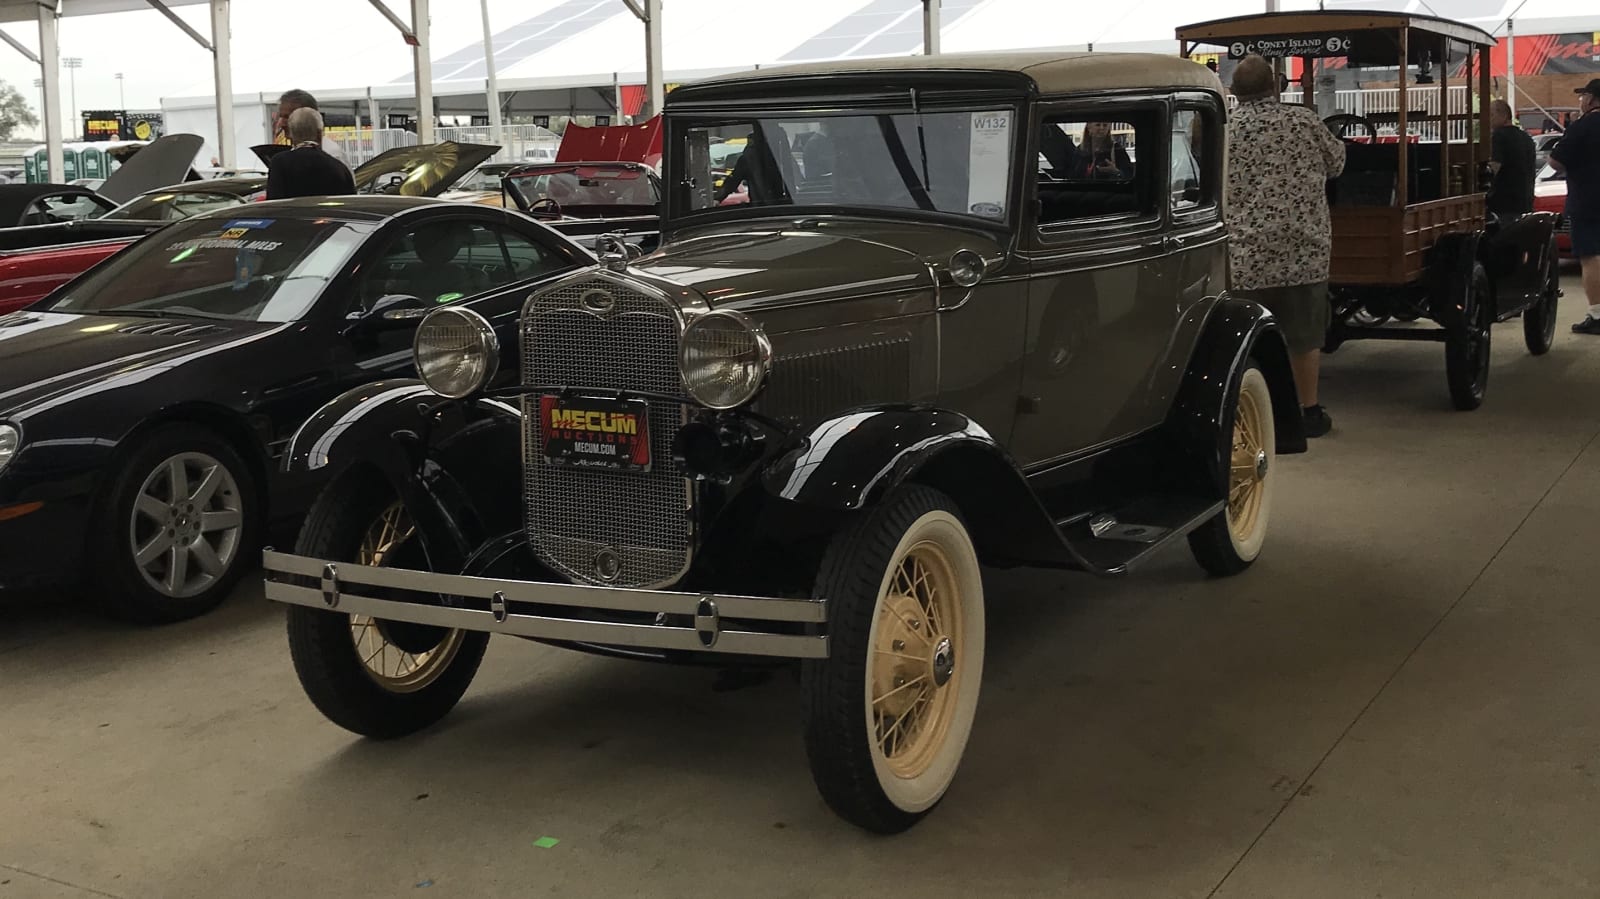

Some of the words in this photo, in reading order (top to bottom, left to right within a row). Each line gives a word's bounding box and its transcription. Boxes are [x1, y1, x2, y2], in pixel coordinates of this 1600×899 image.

[1257, 40, 1288, 50] CONEY
[1289, 38, 1322, 48] ISLAND
[974, 118, 1007, 129] W132
[551, 408, 637, 435] MECUM
[551, 430, 638, 445] AUCTIONS
[574, 441, 617, 455] MECUM.COM
